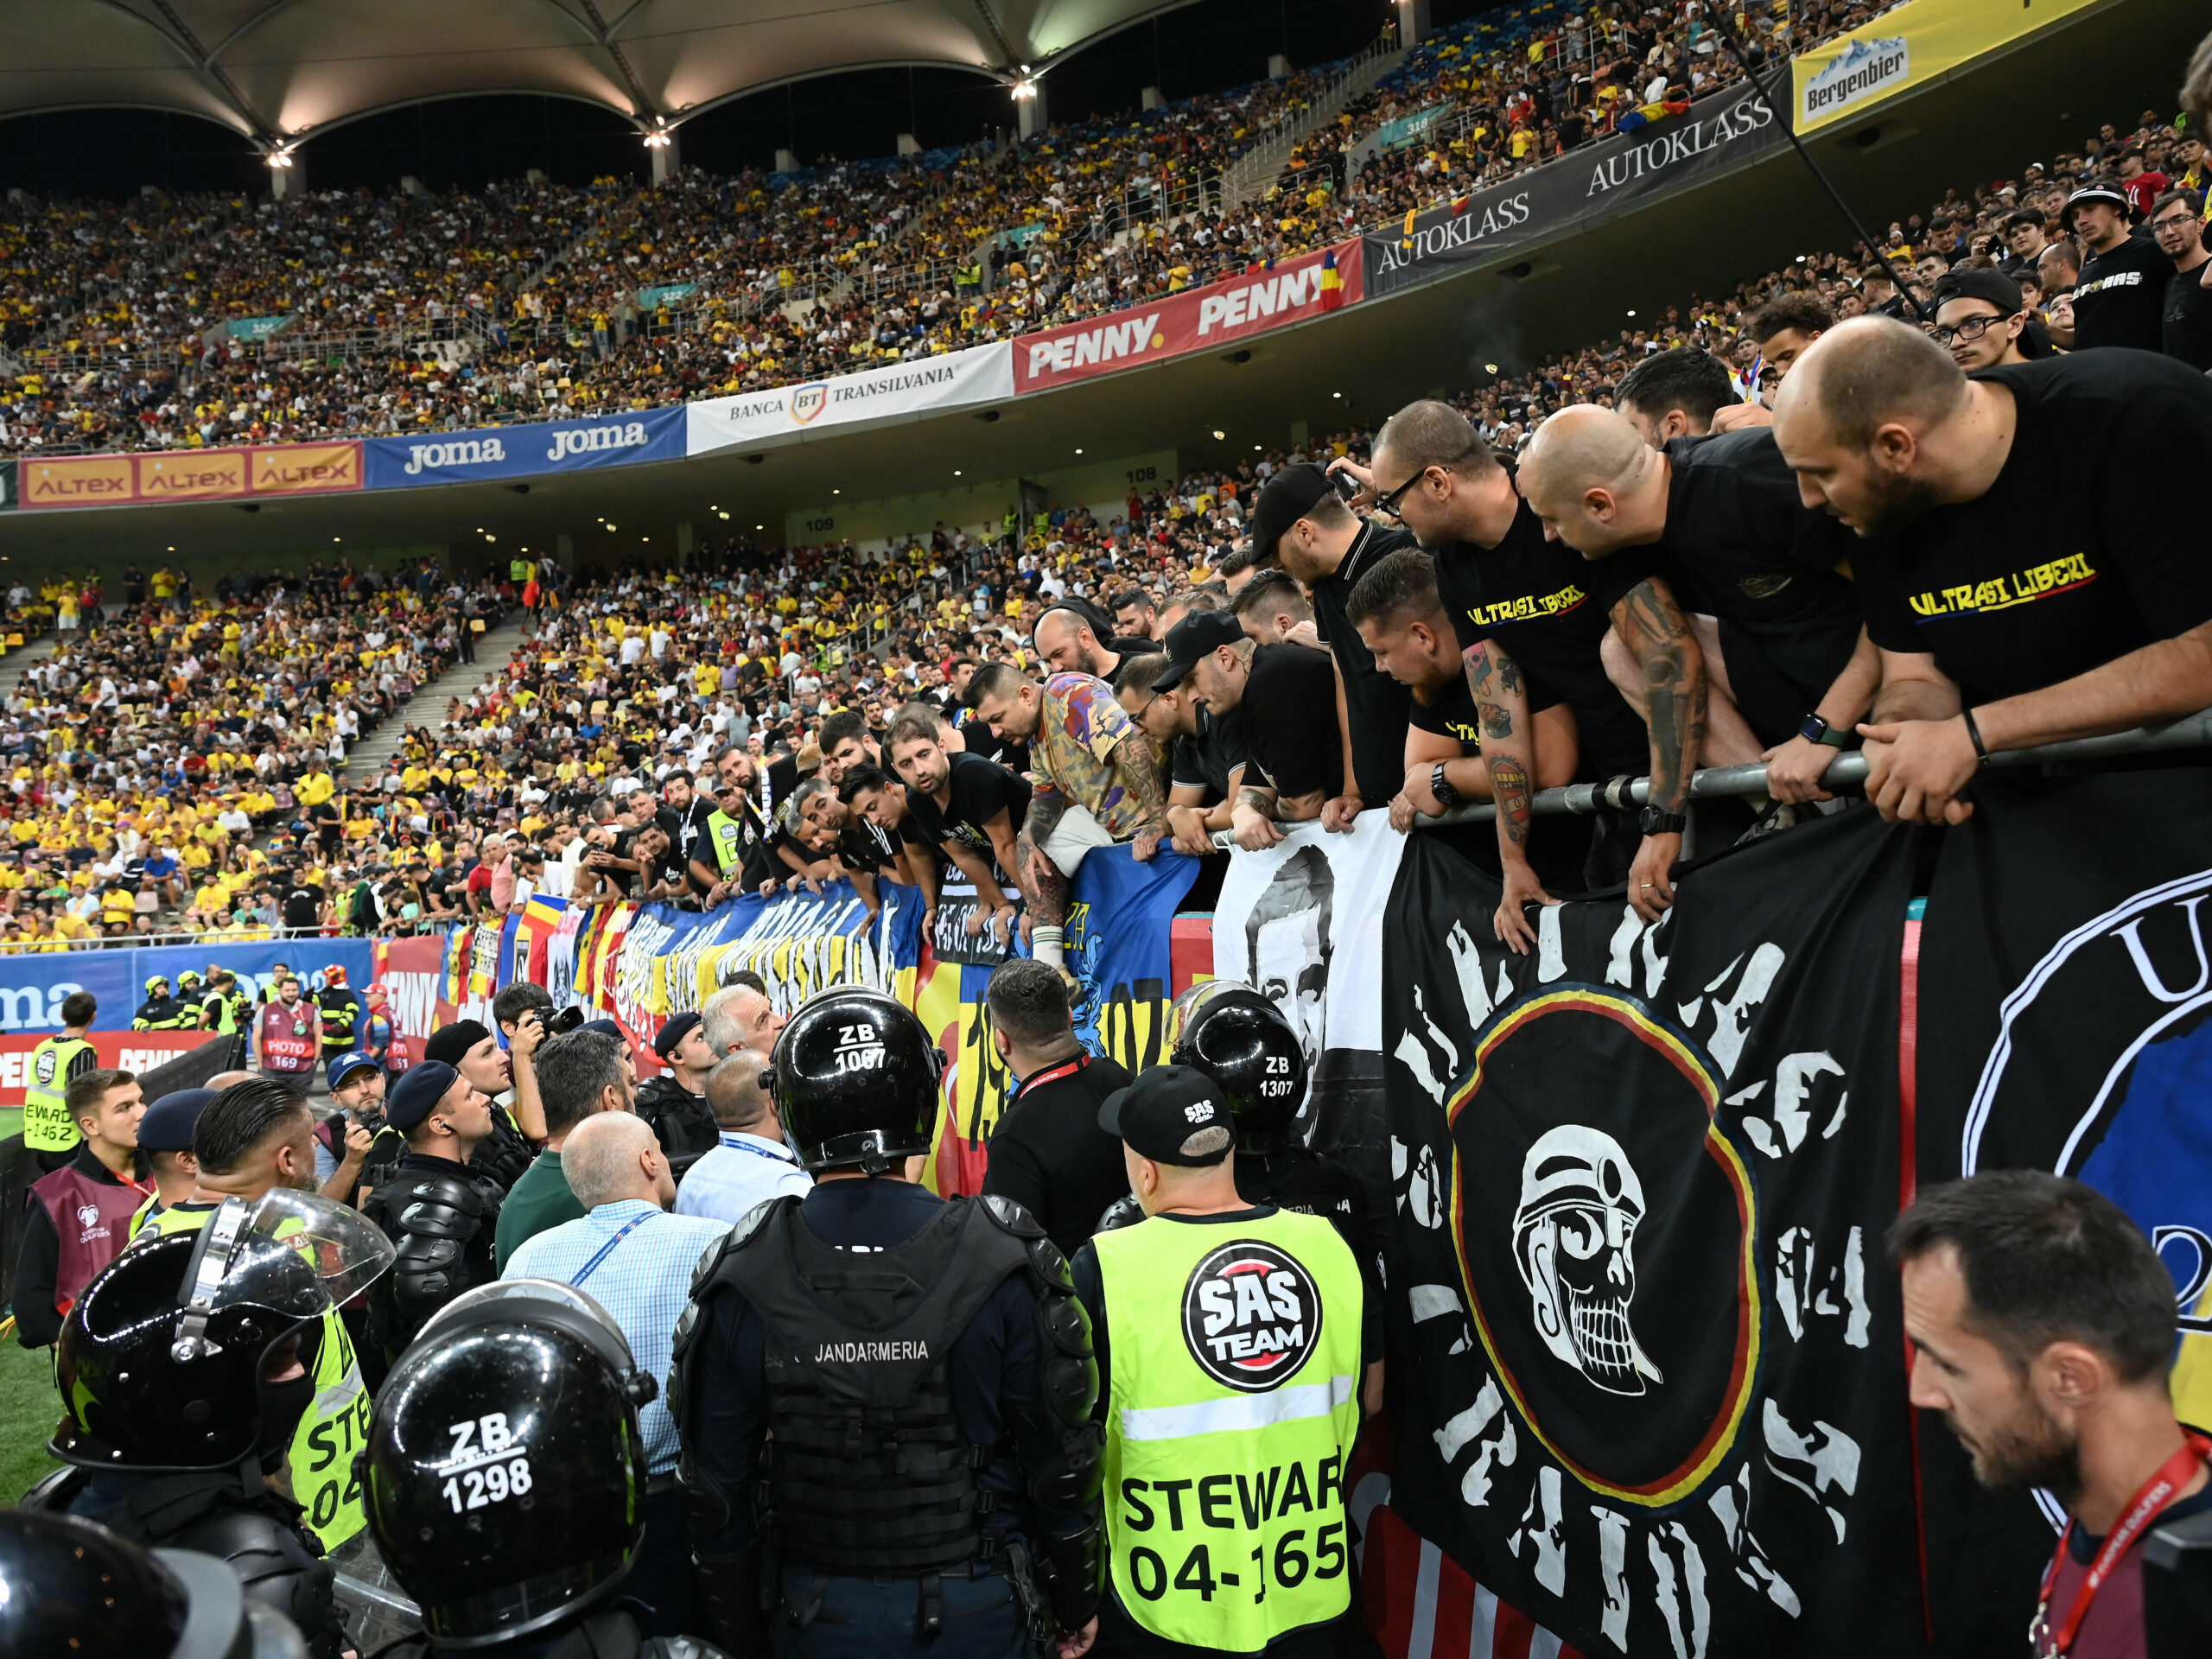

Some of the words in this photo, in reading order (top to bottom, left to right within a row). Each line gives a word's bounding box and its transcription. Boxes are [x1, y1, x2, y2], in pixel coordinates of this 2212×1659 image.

[1808, 51, 1904, 112] Bergenbier
[1407, 118, 1428, 135] 318
[1586, 96, 1773, 197] AUTOKLASS
[1377, 191, 1529, 275] AUTOKLASS
[729, 400, 784, 421] BANCA
[798, 393, 821, 409] BT
[833, 366, 955, 403] TRANSILVANIA
[1125, 467, 1156, 484] 108
[804, 518, 834, 532] 109
[1909, 577, 2012, 615] ULTRASI
[2012, 552, 2096, 597] LIBERI
[838, 1023, 875, 1045] ZB
[835, 1047, 886, 1075] 1067
[1266, 1057, 1289, 1073] ZB
[1259, 1080, 1294, 1097] 1307
[1184, 1099, 1215, 1122] SAS
[1198, 1270, 1302, 1338] SAS
[815, 1340, 930, 1363] JANDARMERIA
[1205, 1323, 1305, 1363] TEAM
[448, 1411, 513, 1461] ZB
[442, 1458, 532, 1514] 1298
